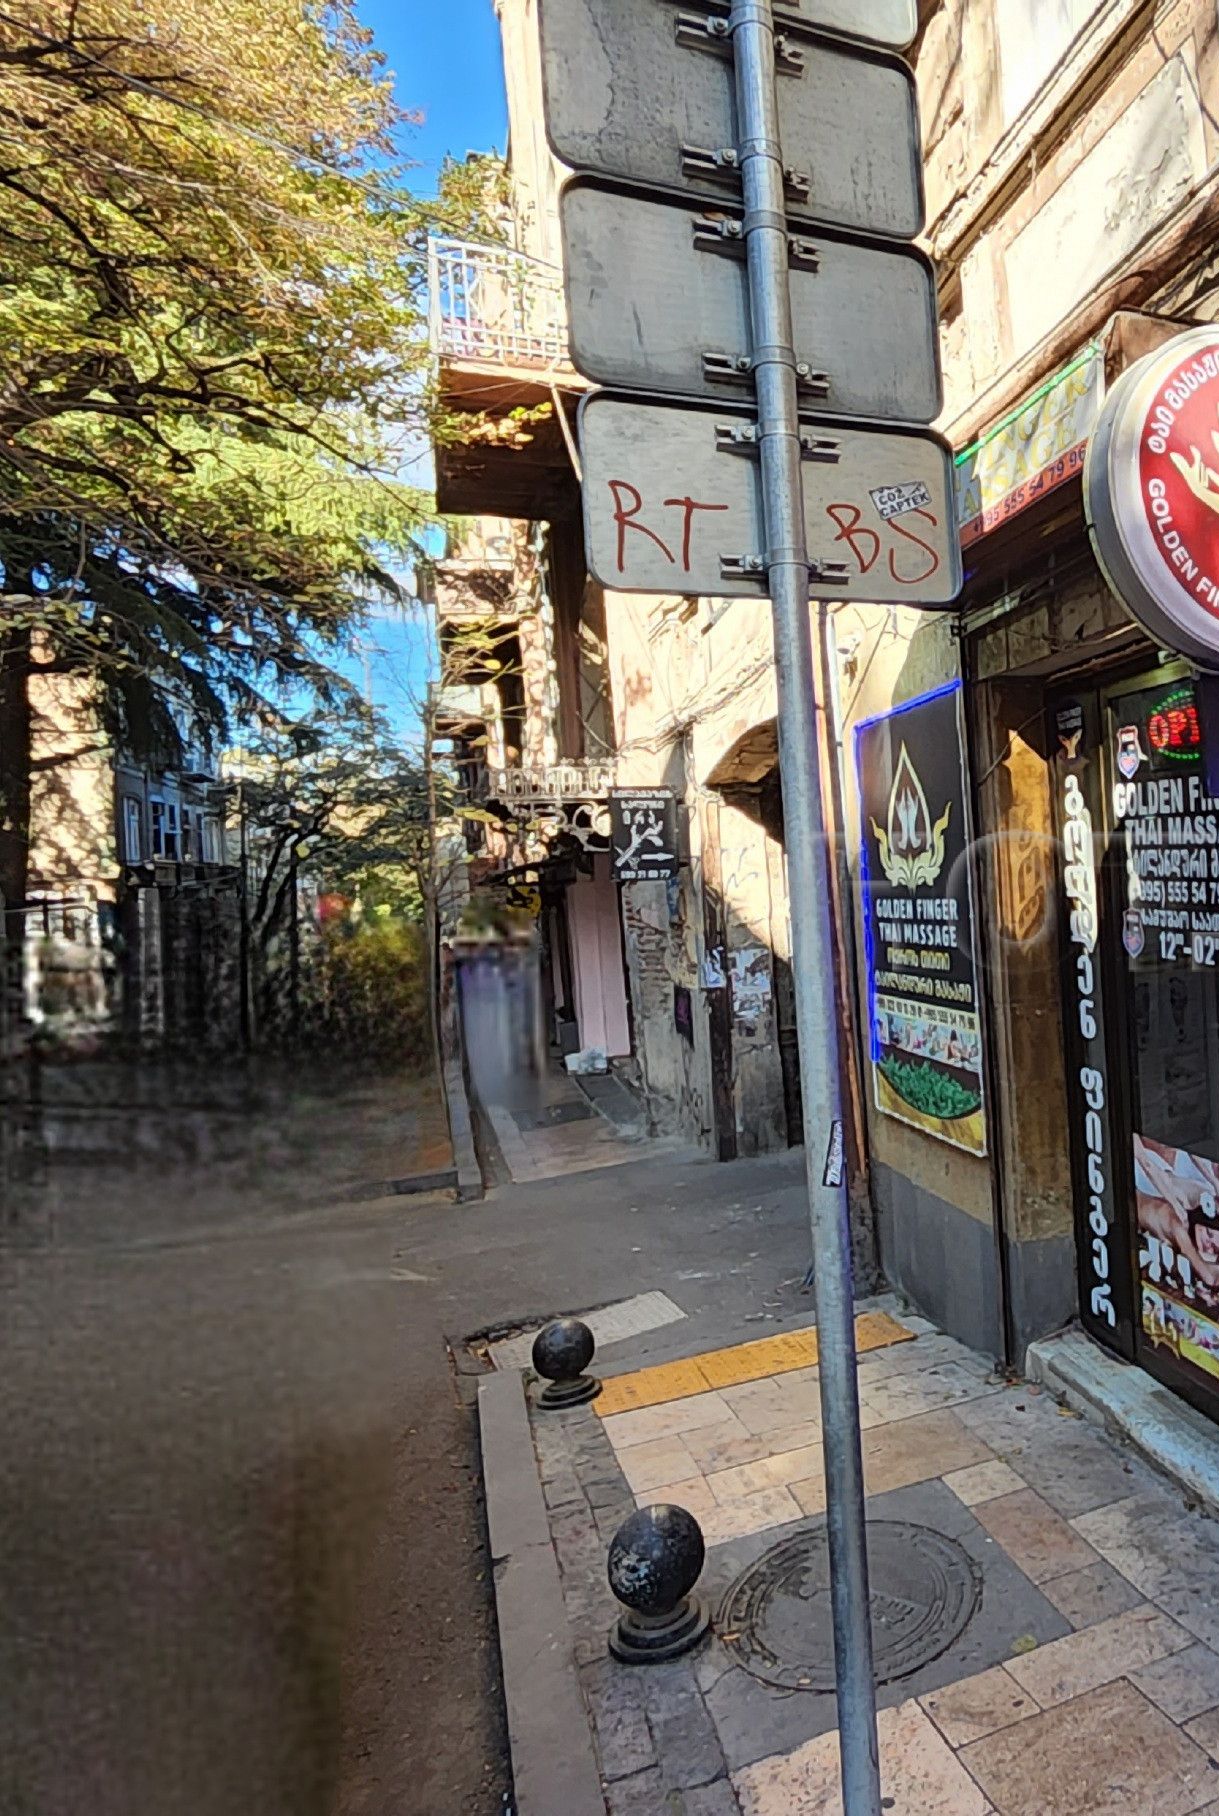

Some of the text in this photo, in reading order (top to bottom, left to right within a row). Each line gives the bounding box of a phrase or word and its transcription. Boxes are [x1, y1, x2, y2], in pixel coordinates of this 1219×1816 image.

[1148, 478, 1199, 582] GOLDEN
[1114, 777, 1184, 818] GOLDEN
[1125, 817, 1162, 846] THAI
[1168, 881, 1188, 903] 555
[1191, 881, 1207, 904] 54
[876, 898, 959, 921] GOLDEN FINGER
[878, 922, 958, 947] THAI MASSAGE
